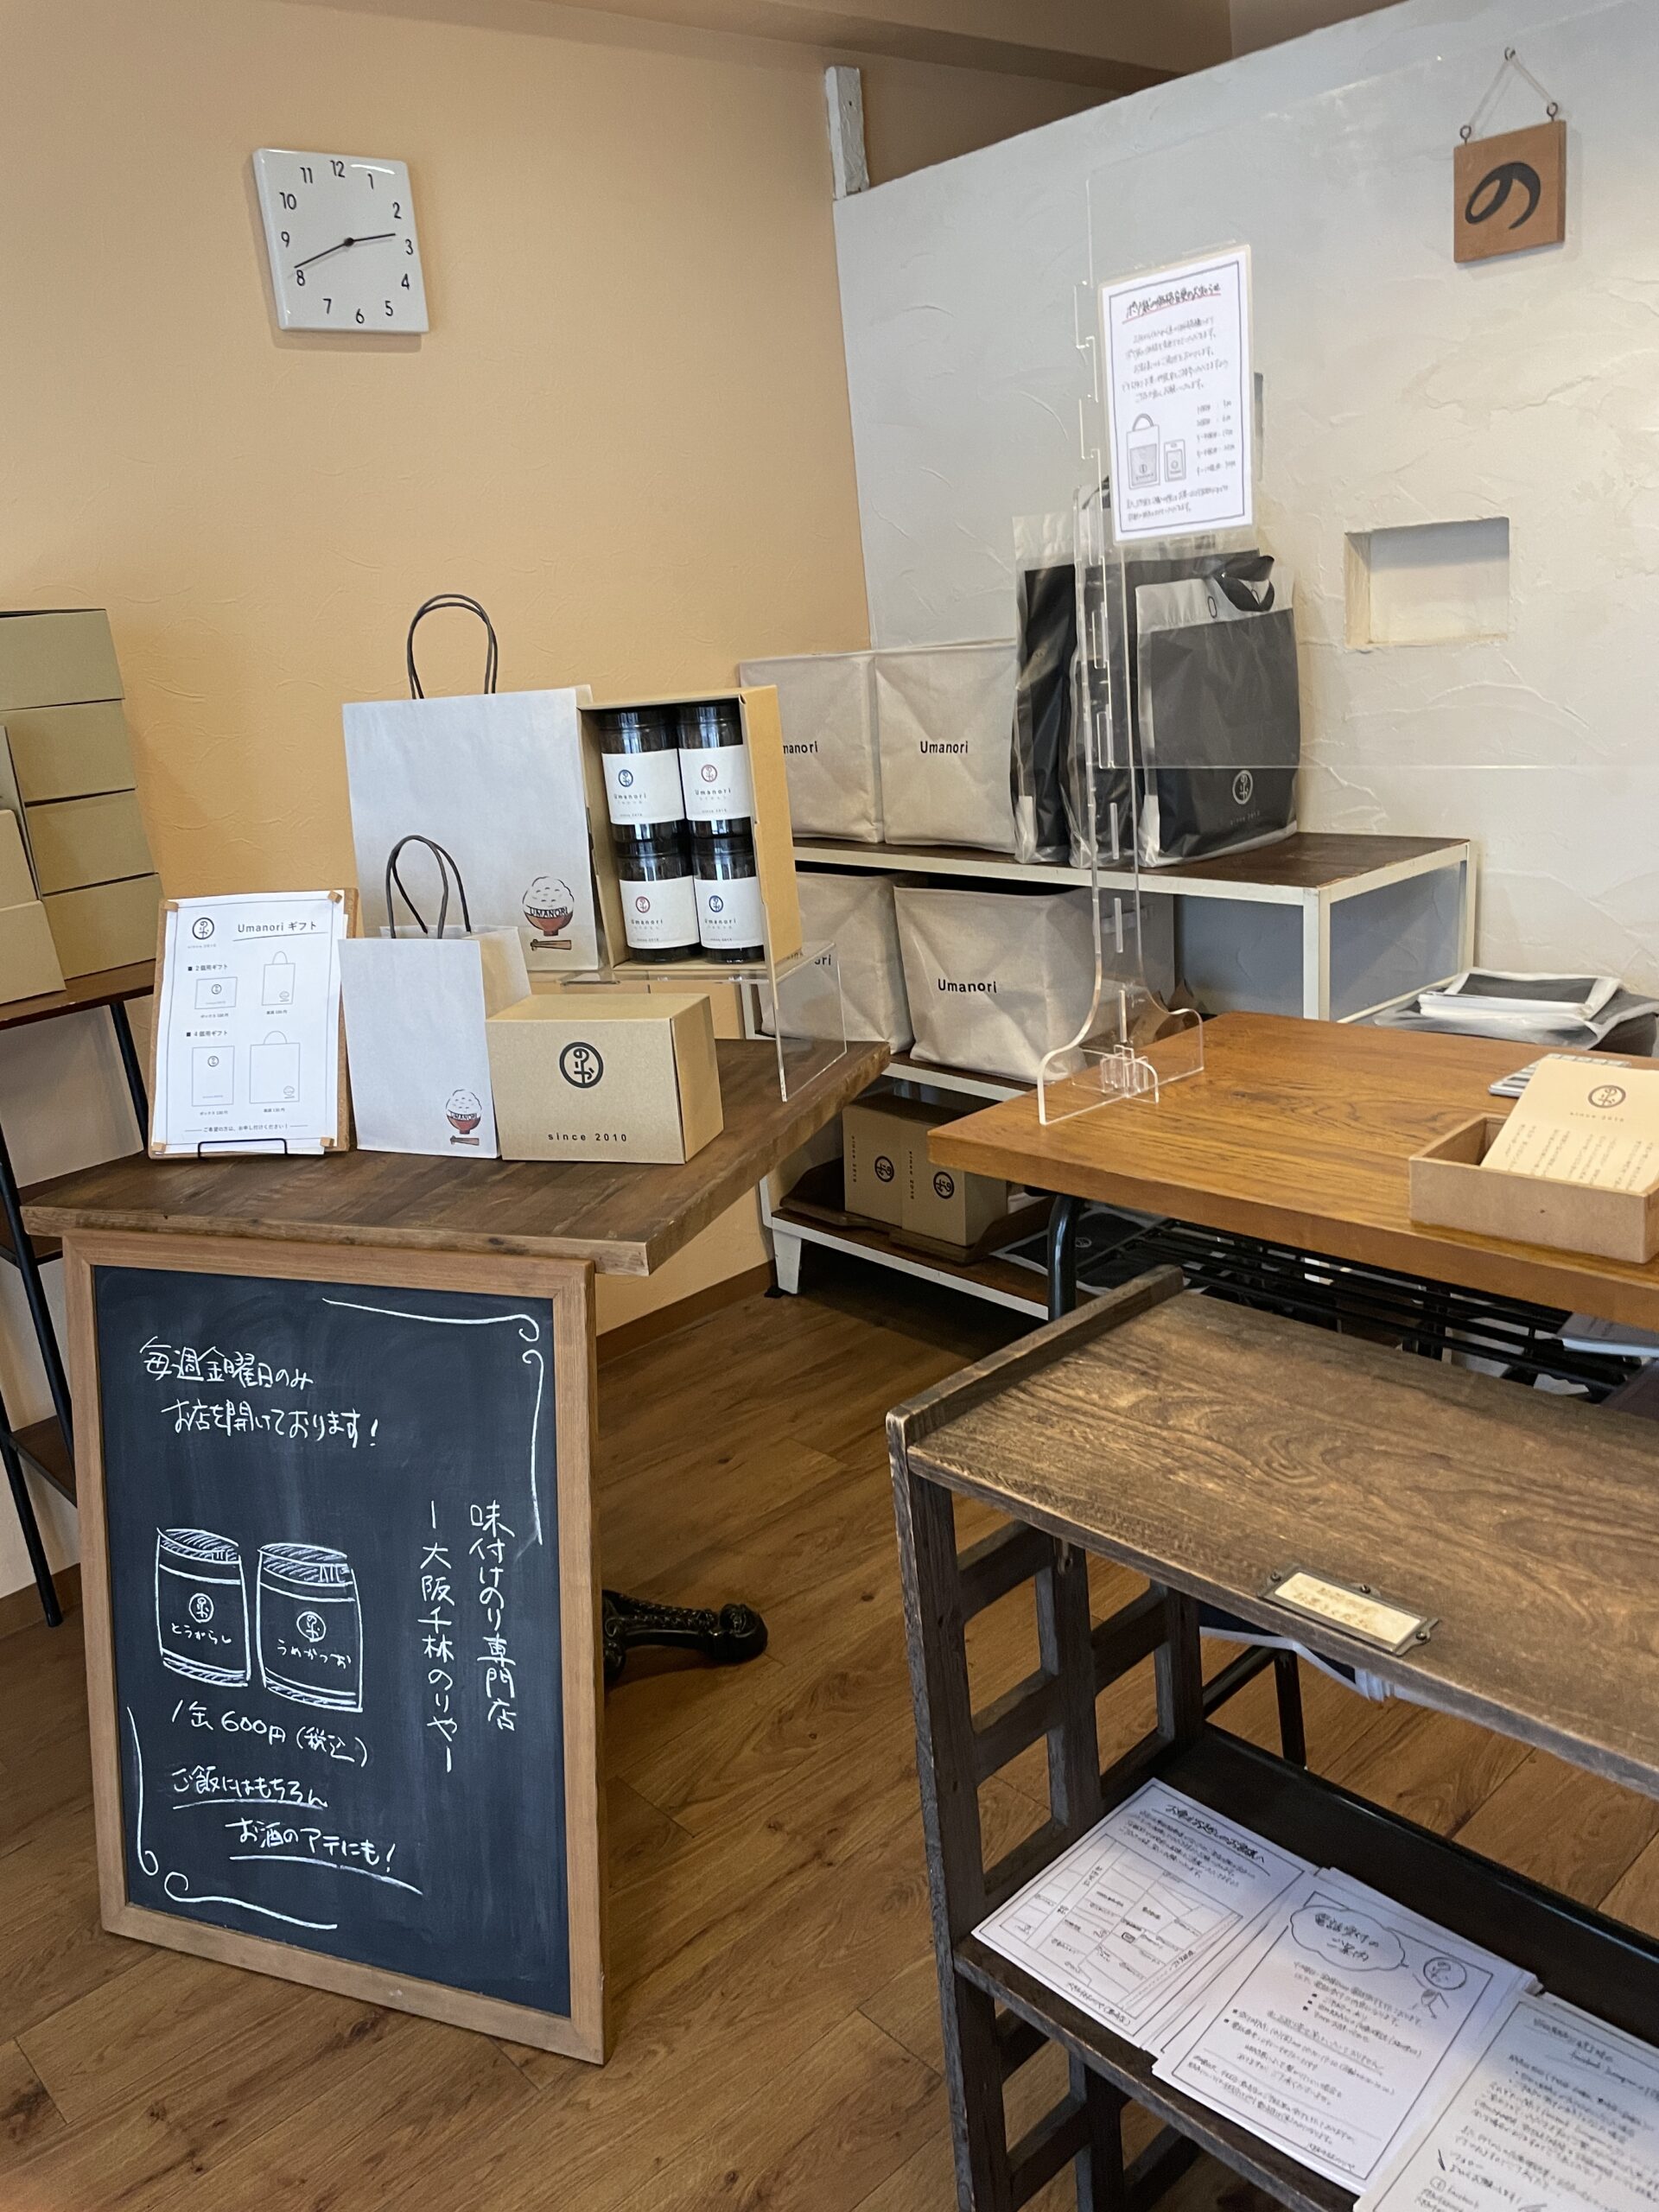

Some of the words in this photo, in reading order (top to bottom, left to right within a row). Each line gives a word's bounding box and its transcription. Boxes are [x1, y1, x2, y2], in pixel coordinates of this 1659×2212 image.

[300, 167, 314, 184] 11
[330, 160, 346, 178] 12
[367, 174, 374, 189] 1
[279, 192, 297, 210] 10
[1465, 160, 1541, 230] の
[392, 201, 402, 219] 2
[281, 231, 290, 248] 9
[404, 238, 414, 255] 3
[296, 270, 306, 287] 8
[401, 273, 410, 290] 4
[322, 298, 332, 315] 7
[385, 300, 394, 316] 5
[355, 308, 365, 324] 6
[783, 741, 818, 754] manori
[919, 741, 969, 754] Umanori
[694, 787, 731, 796] Umanori
[238, 924, 284, 933] Umanori
[288, 922, 316, 931] ギフト
[938, 978, 997, 994] Umanori
[548, 1133, 586, 1141] since
[594, 1133, 627, 1142] 2010
[138, 1336, 315, 1390] 毎週金曜日のみ
[467, 1499, 517, 1732] 味付けのり専門店
[171, 1622, 232, 1644] とうがらし
[171, 1765, 328, 1808] ご飯にはもちろん
